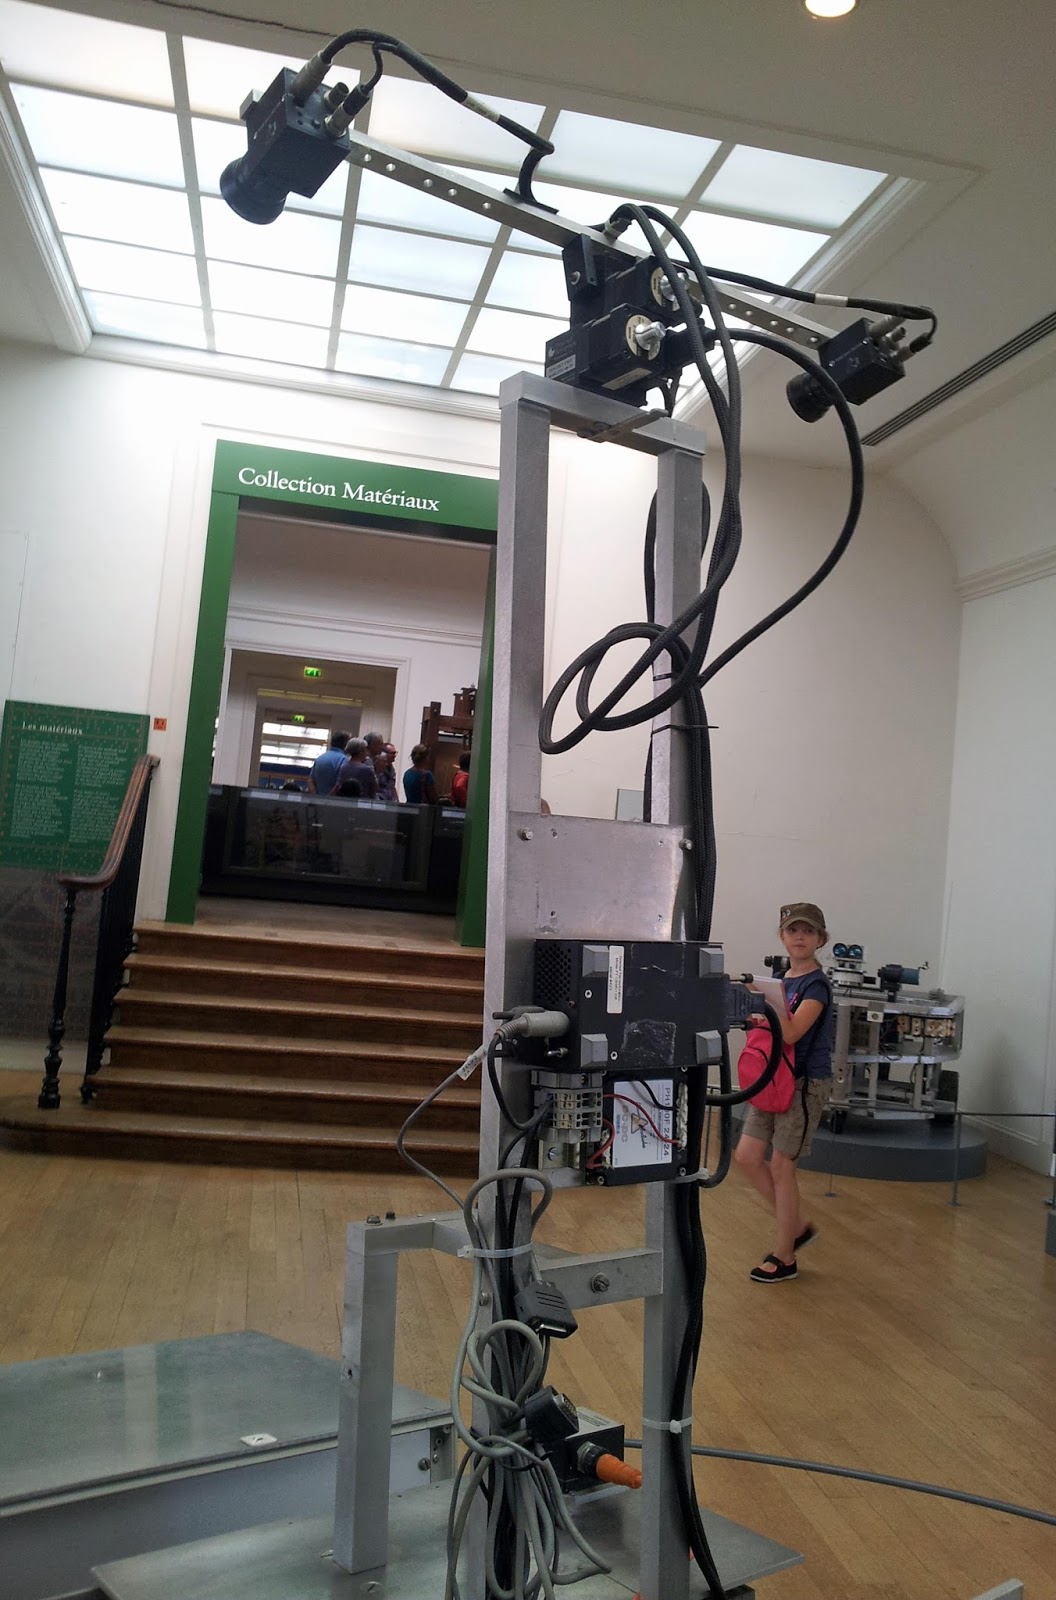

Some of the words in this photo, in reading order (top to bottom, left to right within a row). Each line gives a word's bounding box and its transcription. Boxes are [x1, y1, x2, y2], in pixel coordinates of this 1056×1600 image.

[238, 467, 336, 497] Collection
[341, 482, 441, 512] Matériaux
[22, 720, 37, 731] Les
[663, 1128, 671, 1156] 2424
